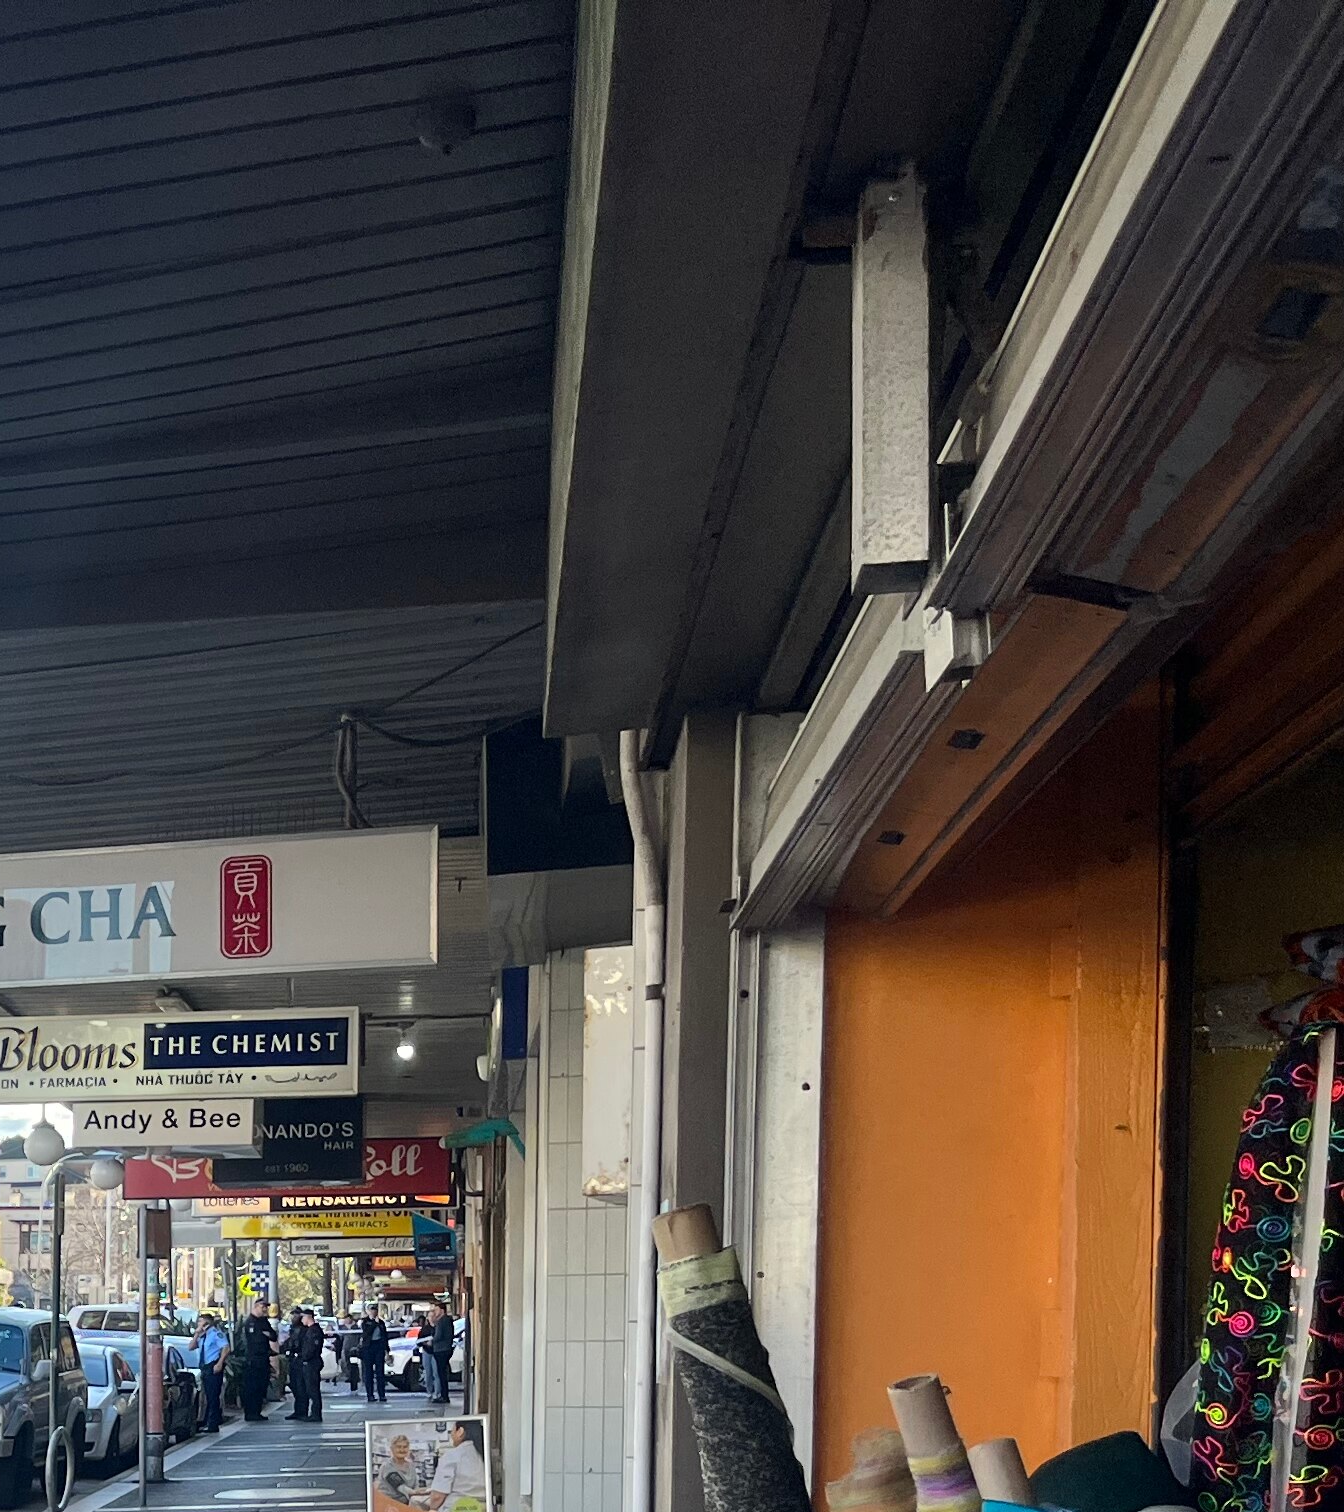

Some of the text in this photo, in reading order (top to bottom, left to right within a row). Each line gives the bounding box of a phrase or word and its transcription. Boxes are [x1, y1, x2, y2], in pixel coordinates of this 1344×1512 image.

[30, 884, 177, 946] CHA
[149, 1031, 340, 1056] THE CHEMIST
[83, 1106, 242, 1133] Andy & Bee
[323, 1141, 354, 1151] HAIR
[290, 1220, 333, 1230] CRYSTALS
